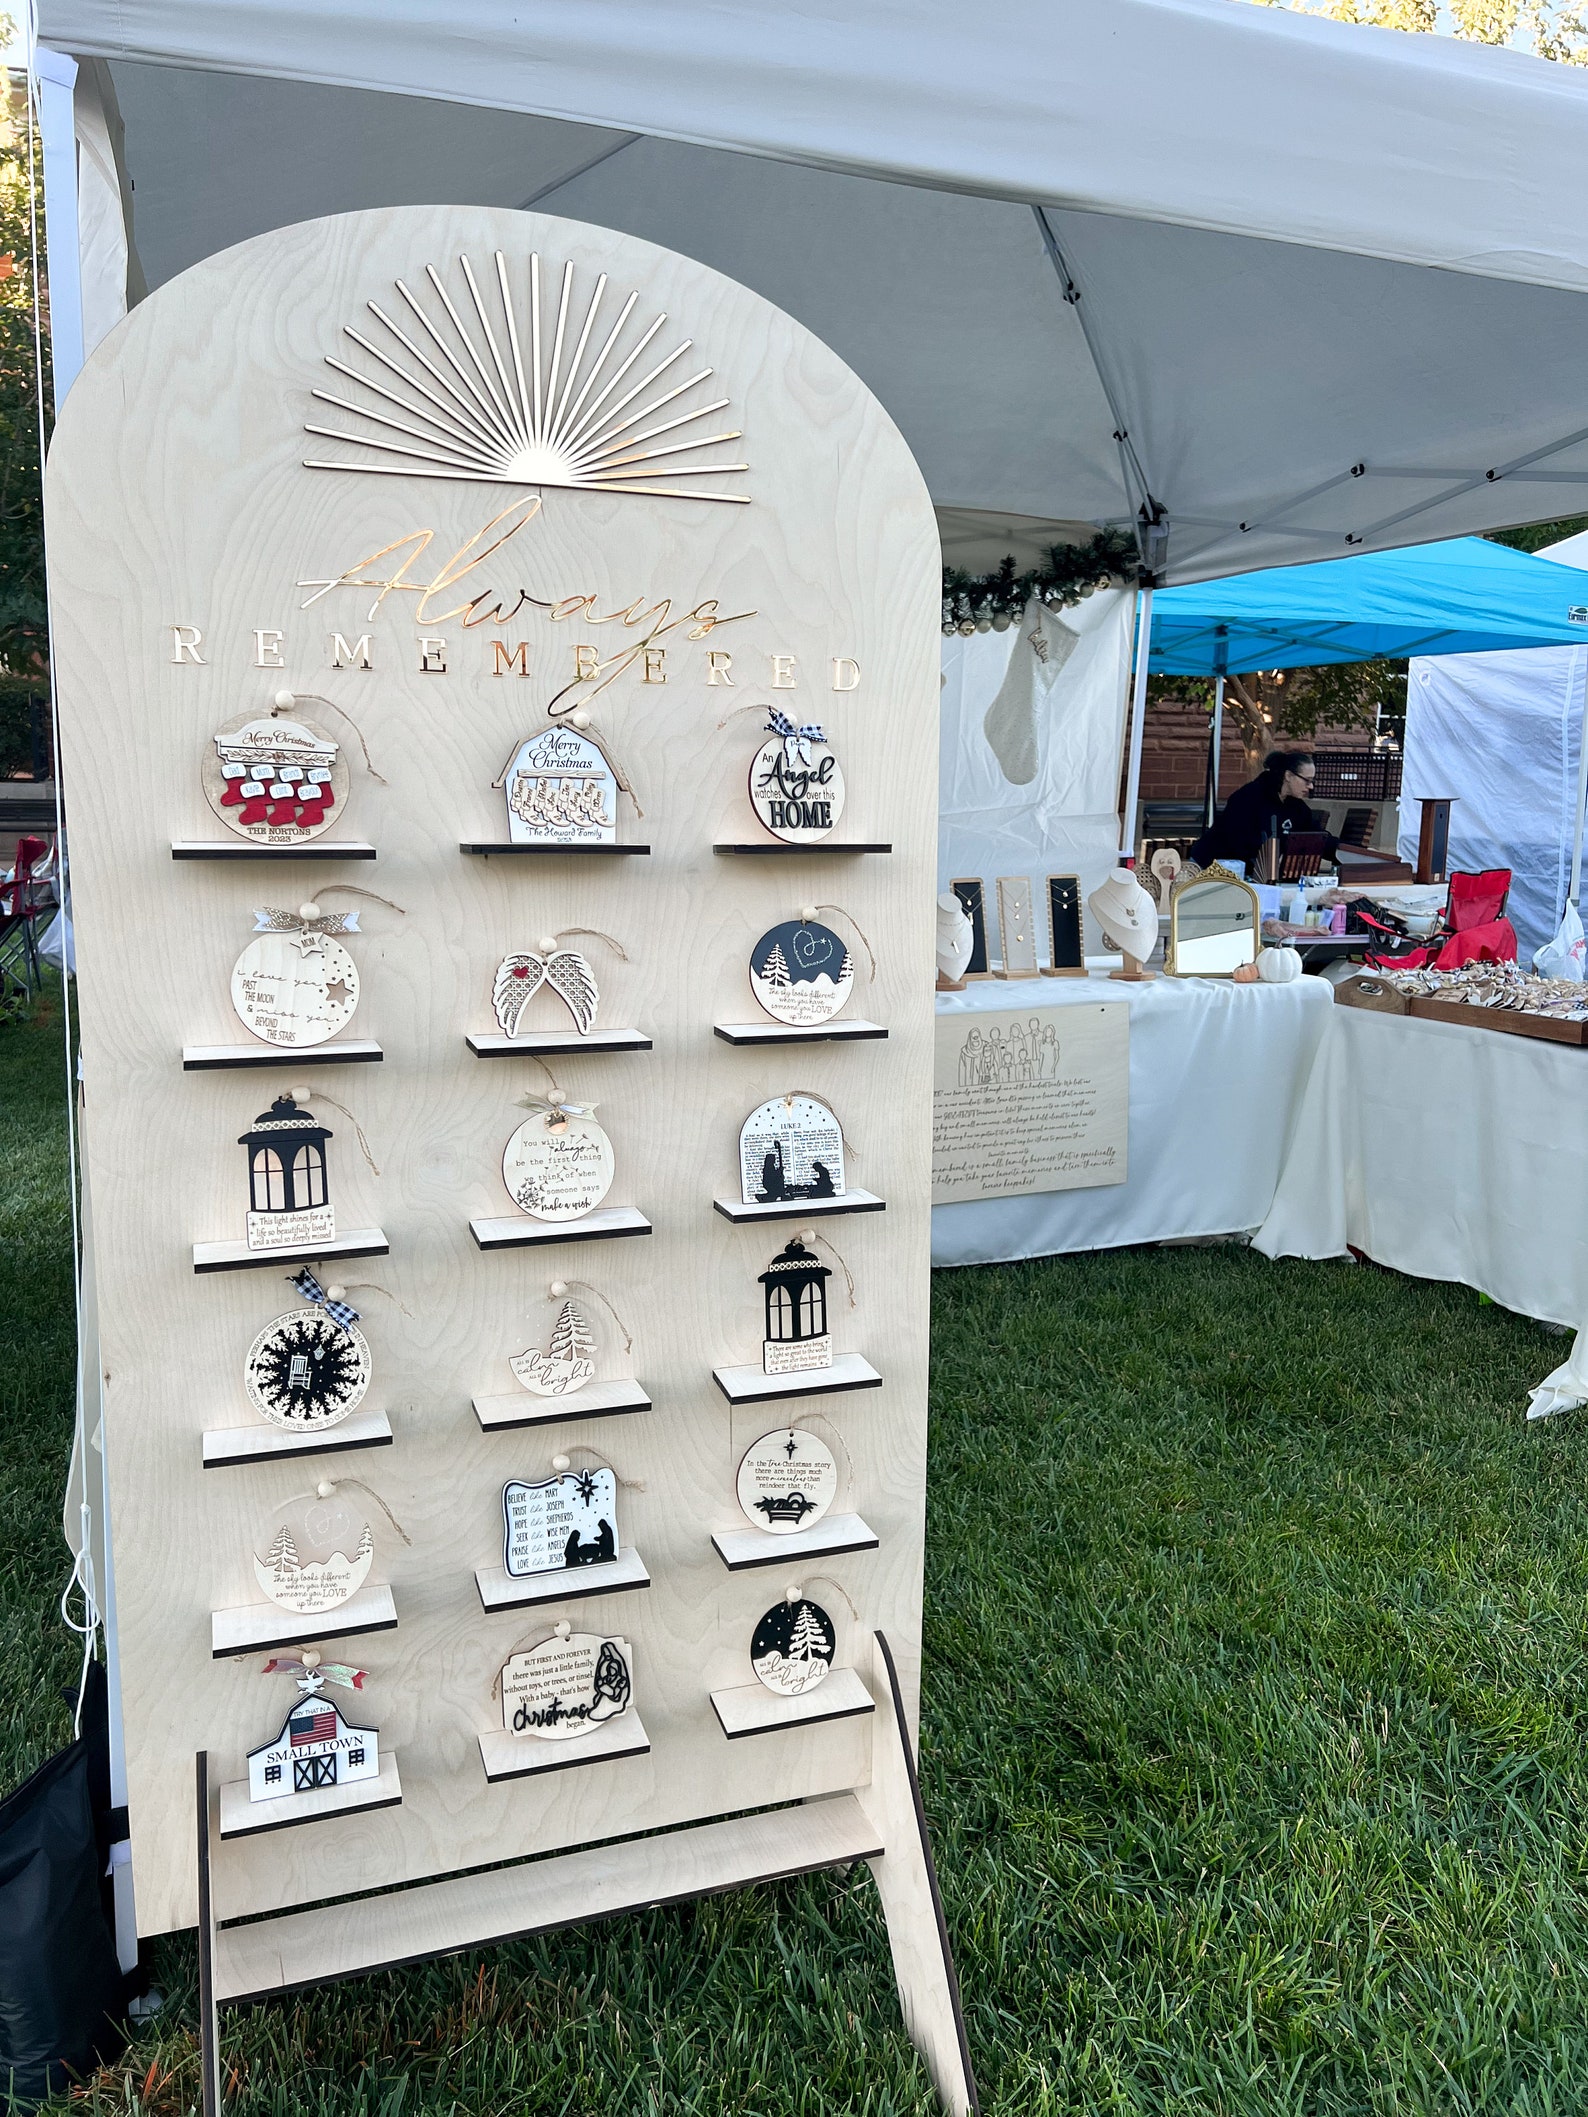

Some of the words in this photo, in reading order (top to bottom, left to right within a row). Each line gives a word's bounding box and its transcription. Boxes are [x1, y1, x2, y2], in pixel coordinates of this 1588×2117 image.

[298, 494, 758, 717] Always
[170, 625, 861, 692] REMEMBERED
[242, 731, 273, 746] Merry
[273, 730, 315, 748] Christmas
[539, 734, 581, 758] Merry
[528, 749, 592, 768] Christmas
[762, 753, 773, 762] An
[758, 752, 835, 800] Angel
[754, 785, 781, 798] watches
[806, 791, 821, 799] over
[823, 790, 835, 800] this
[769, 801, 832, 828] HOME
[526, 827, 542, 836] The
[544, 827, 575, 836] Howard
[577, 828, 602, 840] Family
[301, 937, 316, 948] MOM
[252, 971, 286, 981] love
[242, 980, 257, 990] PAST
[245, 991, 256, 1001] THE
[257, 993, 275, 1004] MOON
[257, 1009, 300, 1017] miss
[307, 1015, 334, 1023] you
[812, 1005, 832, 1014] LOVE
[255, 1016, 278, 1028] BEYOND
[267, 1029, 277, 1039] THE
[278, 1031, 296, 1041] STARS
[554, 1141, 584, 1161] always
[548, 1156, 570, 1164] first
[566, 1171, 574, 1179] of
[541, 1198, 563, 1211] make
[572, 1197, 592, 1210] wish
[259, 1217, 273, 1226] This
[274, 1216, 288, 1226] light
[290, 1216, 308, 1224] shines
[309, 1214, 318, 1223] for
[256, 1229, 267, 1237] life
[277, 1226, 310, 1235] beautifully
[312, 1222, 326, 1231] loved
[252, 1238, 264, 1246] and
[271, 1236, 283, 1244] soul
[292, 1233, 310, 1243] deeply
[312, 1230, 332, 1239] missed
[518, 1353, 559, 1374] calm
[541, 1361, 592, 1393] bright
[508, 1493, 526, 1504] BELIEVE
[529, 1491, 542, 1500] like
[545, 1488, 558, 1498] MARY
[512, 1506, 527, 1517] TRUST
[530, 1504, 543, 1514] like
[546, 1500, 565, 1512] JOSEPH
[514, 1520, 527, 1530] HOPE
[530, 1518, 544, 1527] like
[546, 1512, 574, 1525] SHEPHERDS
[516, 1533, 528, 1542] SEEK
[530, 1531, 544, 1540] like
[547, 1528, 558, 1537] WISE
[560, 1526, 569, 1535] MEN
[512, 1546, 528, 1556] PRAISE
[531, 1544, 544, 1553] like
[547, 1540, 566, 1551] ANGELS
[517, 1560, 529, 1569] LOVE
[532, 1558, 545, 1566] like
[548, 1554, 563, 1564] JESUS
[287, 1575, 299, 1585] sky
[320, 1573, 350, 1583] different
[307, 1584, 319, 1592] you
[309, 1592, 321, 1601] you
[322, 1588, 347, 1598] LOVE
[524, 1658, 536, 1666] BUT
[552, 1654, 566, 1662] AND
[566, 1648, 591, 1659] FOREVER
[512, 1672, 529, 1680] there
[542, 1667, 554, 1676] just
[559, 1663, 573, 1672] little
[574, 1660, 594, 1670] family,
[760, 1655, 797, 1676] calm
[781, 1661, 826, 1693] bright
[504, 1685, 528, 1694] without
[529, 1682, 542, 1690] toys,
[552, 1678, 568, 1686] trees,
[519, 1695, 535, 1703] With
[540, 1691, 556, 1702] baby
[560, 1687, 576, 1696] that's
[577, 1685, 590, 1693] how
[513, 1697, 590, 1731] Christmas
[566, 1720, 586, 1729] began.
[267, 1747, 317, 1764] SMALL
[319, 1735, 364, 1752] TOWN
